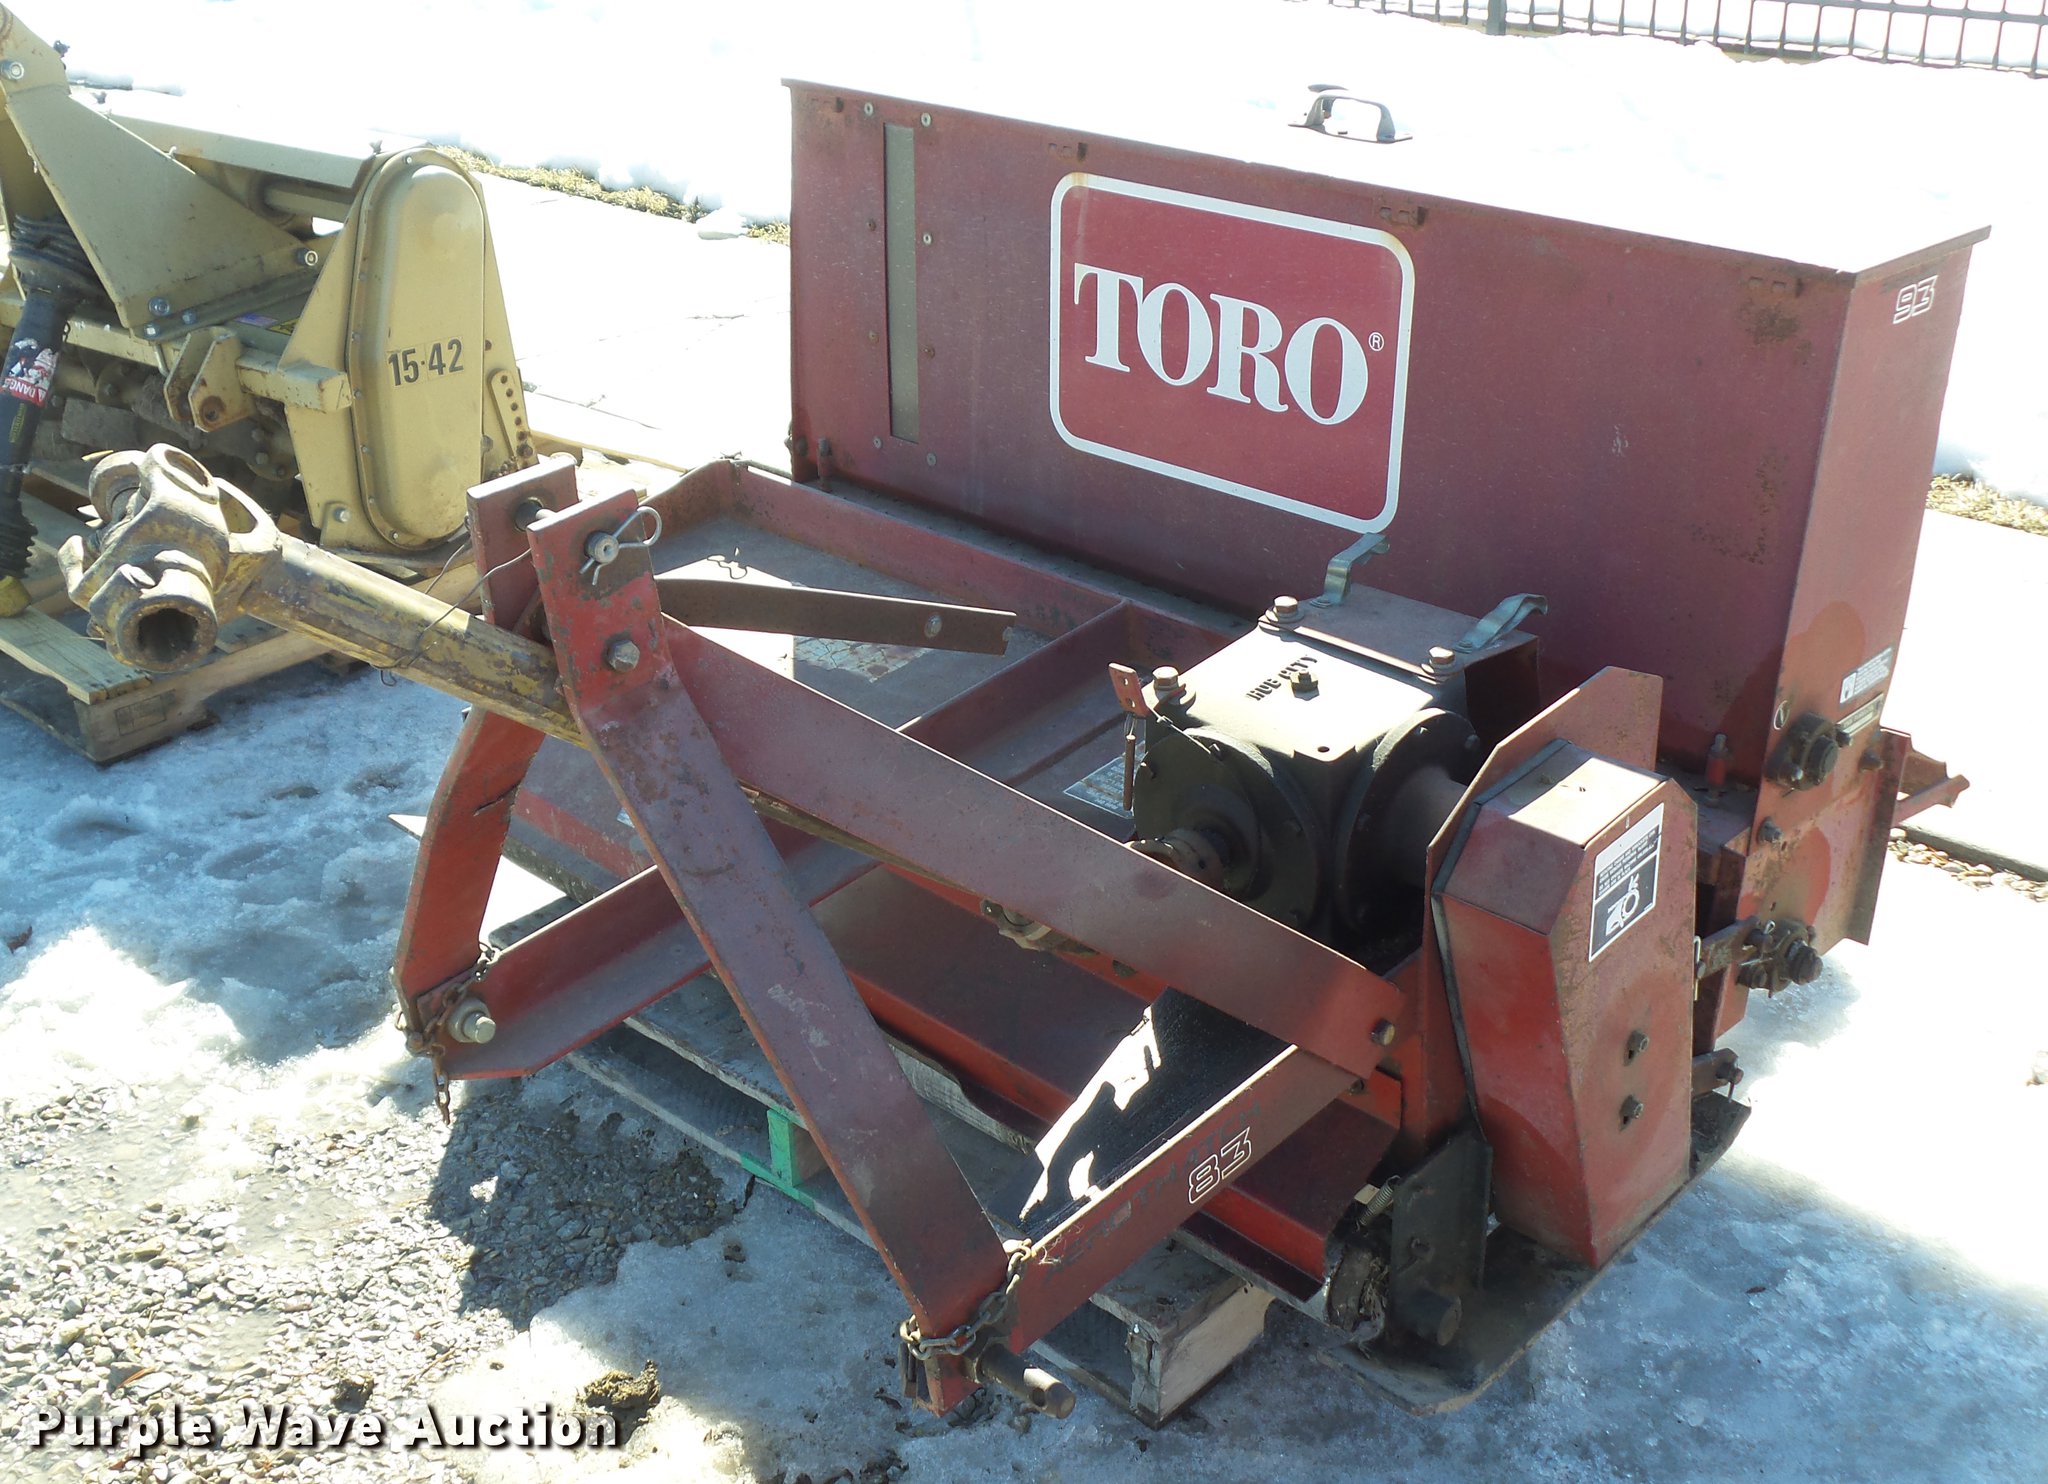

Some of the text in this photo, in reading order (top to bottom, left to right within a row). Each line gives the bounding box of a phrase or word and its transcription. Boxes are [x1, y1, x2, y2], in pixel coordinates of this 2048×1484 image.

[1893, 275, 1939, 325] 93
[1074, 262, 1369, 425] TORO
[1188, 1126, 1252, 1204] 83
